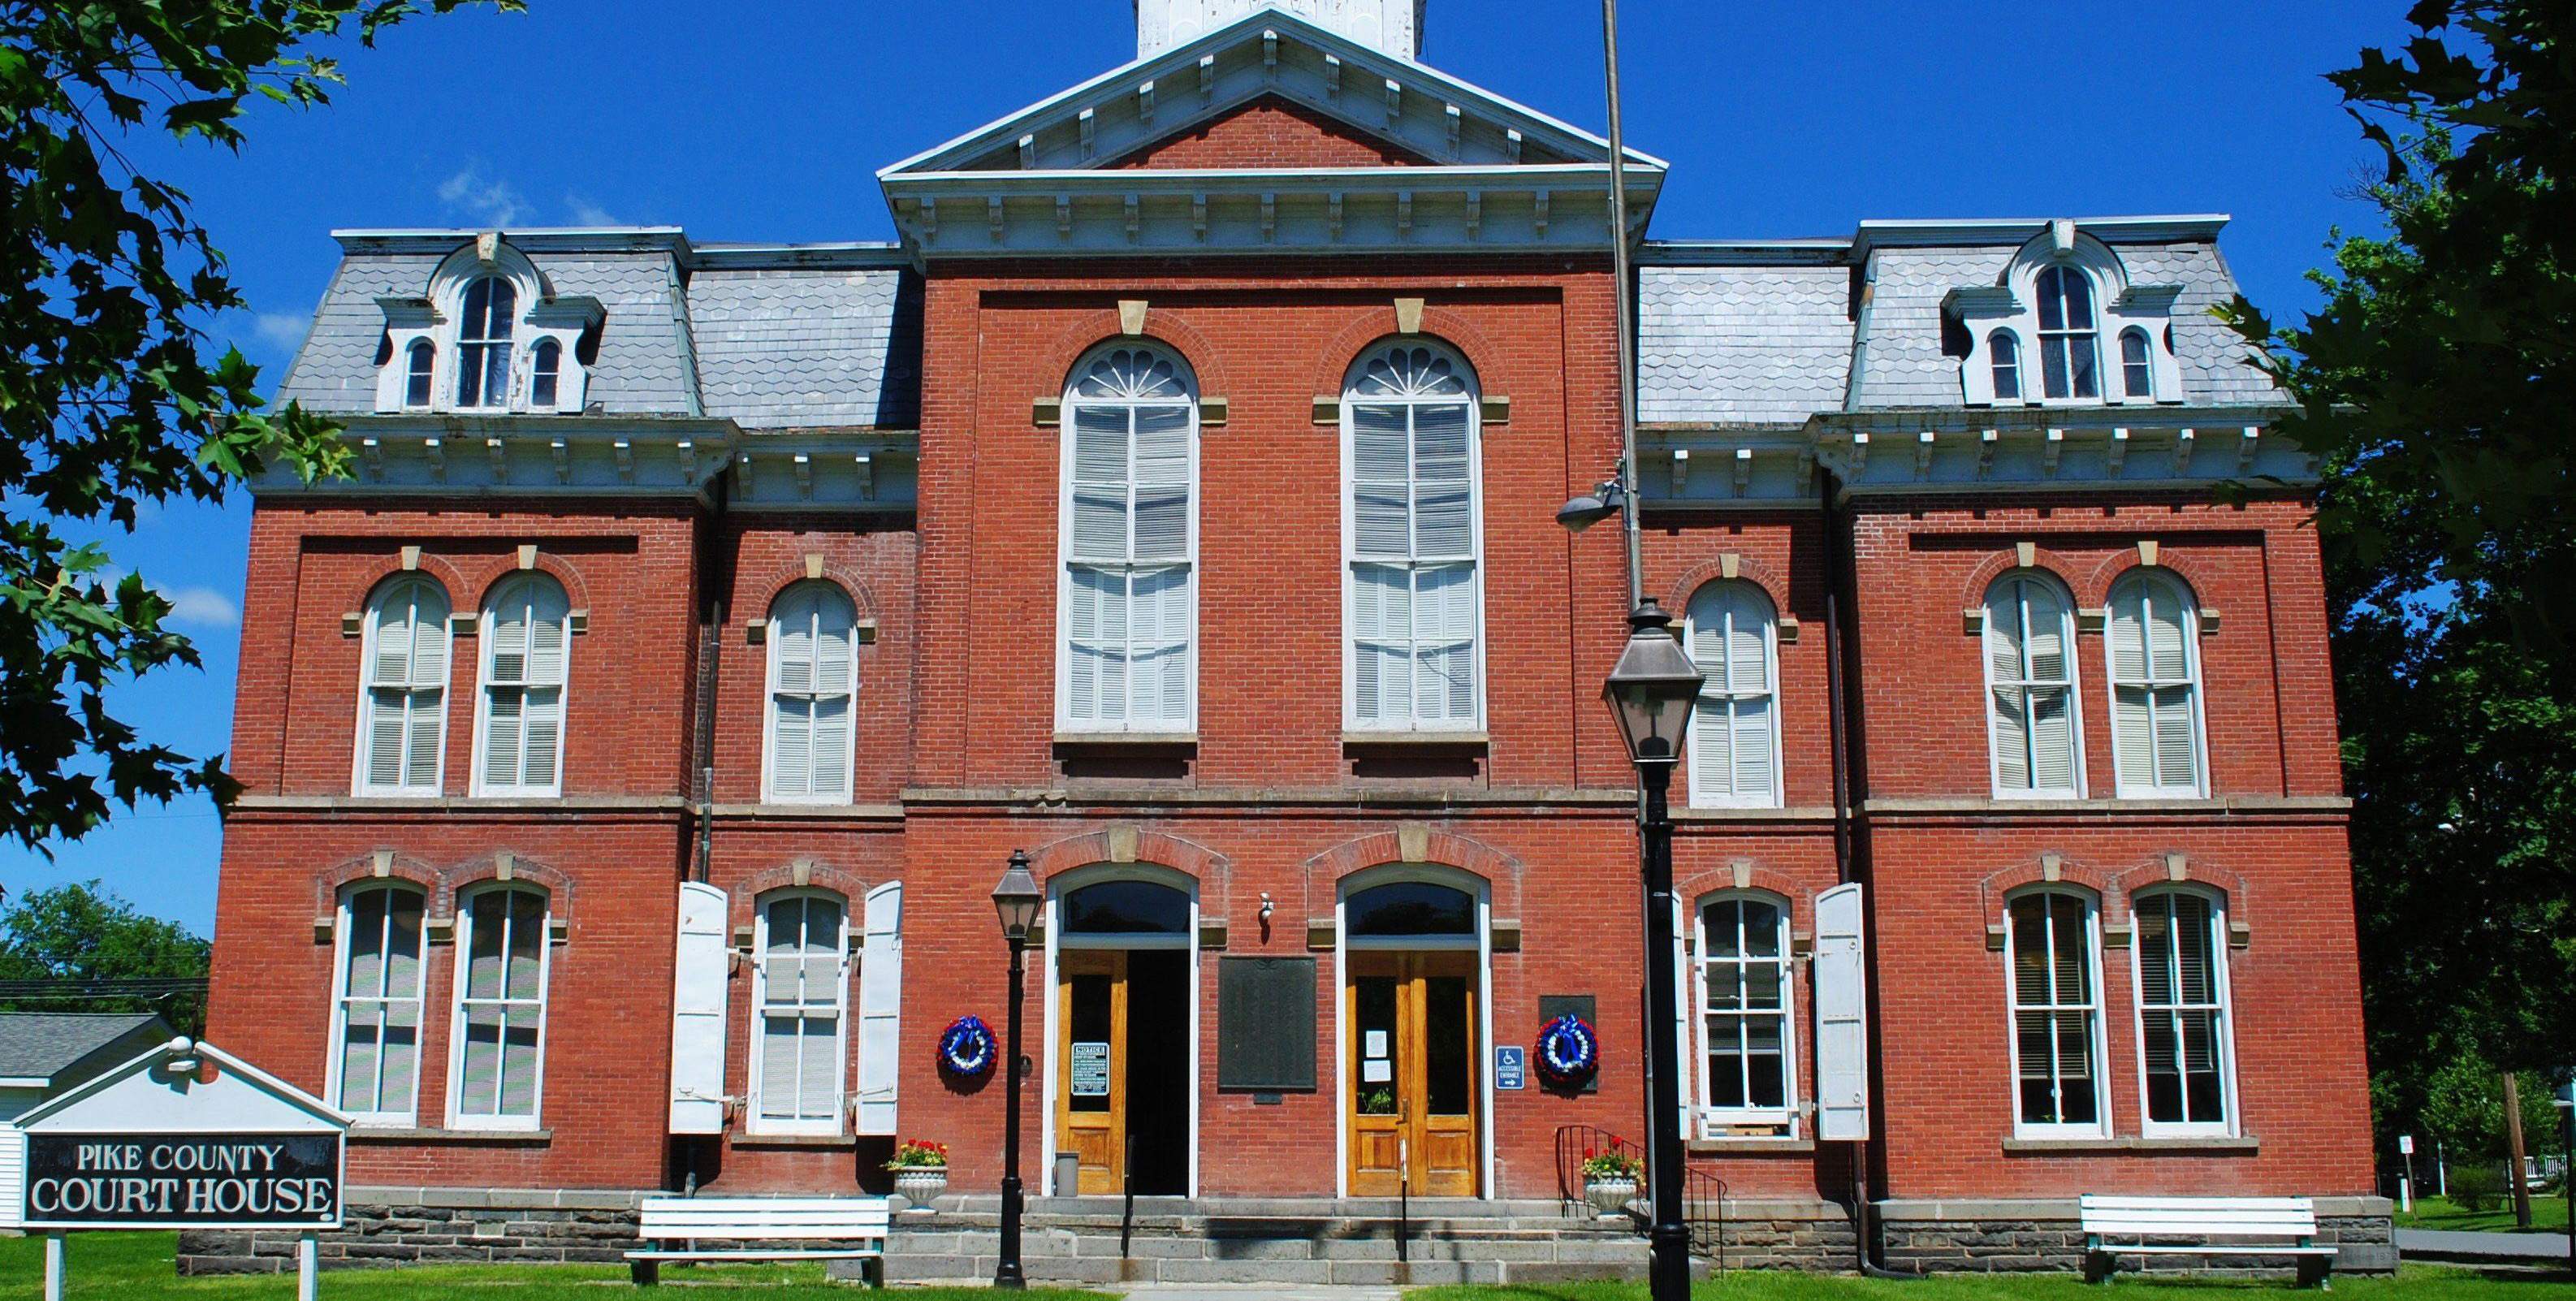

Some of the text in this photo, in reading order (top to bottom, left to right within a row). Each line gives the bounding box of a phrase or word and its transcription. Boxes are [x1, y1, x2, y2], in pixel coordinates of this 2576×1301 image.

[77, 1144, 283, 1176] PIKE COUNTY
[32, 1178, 333, 1213] COURT HOUSE
